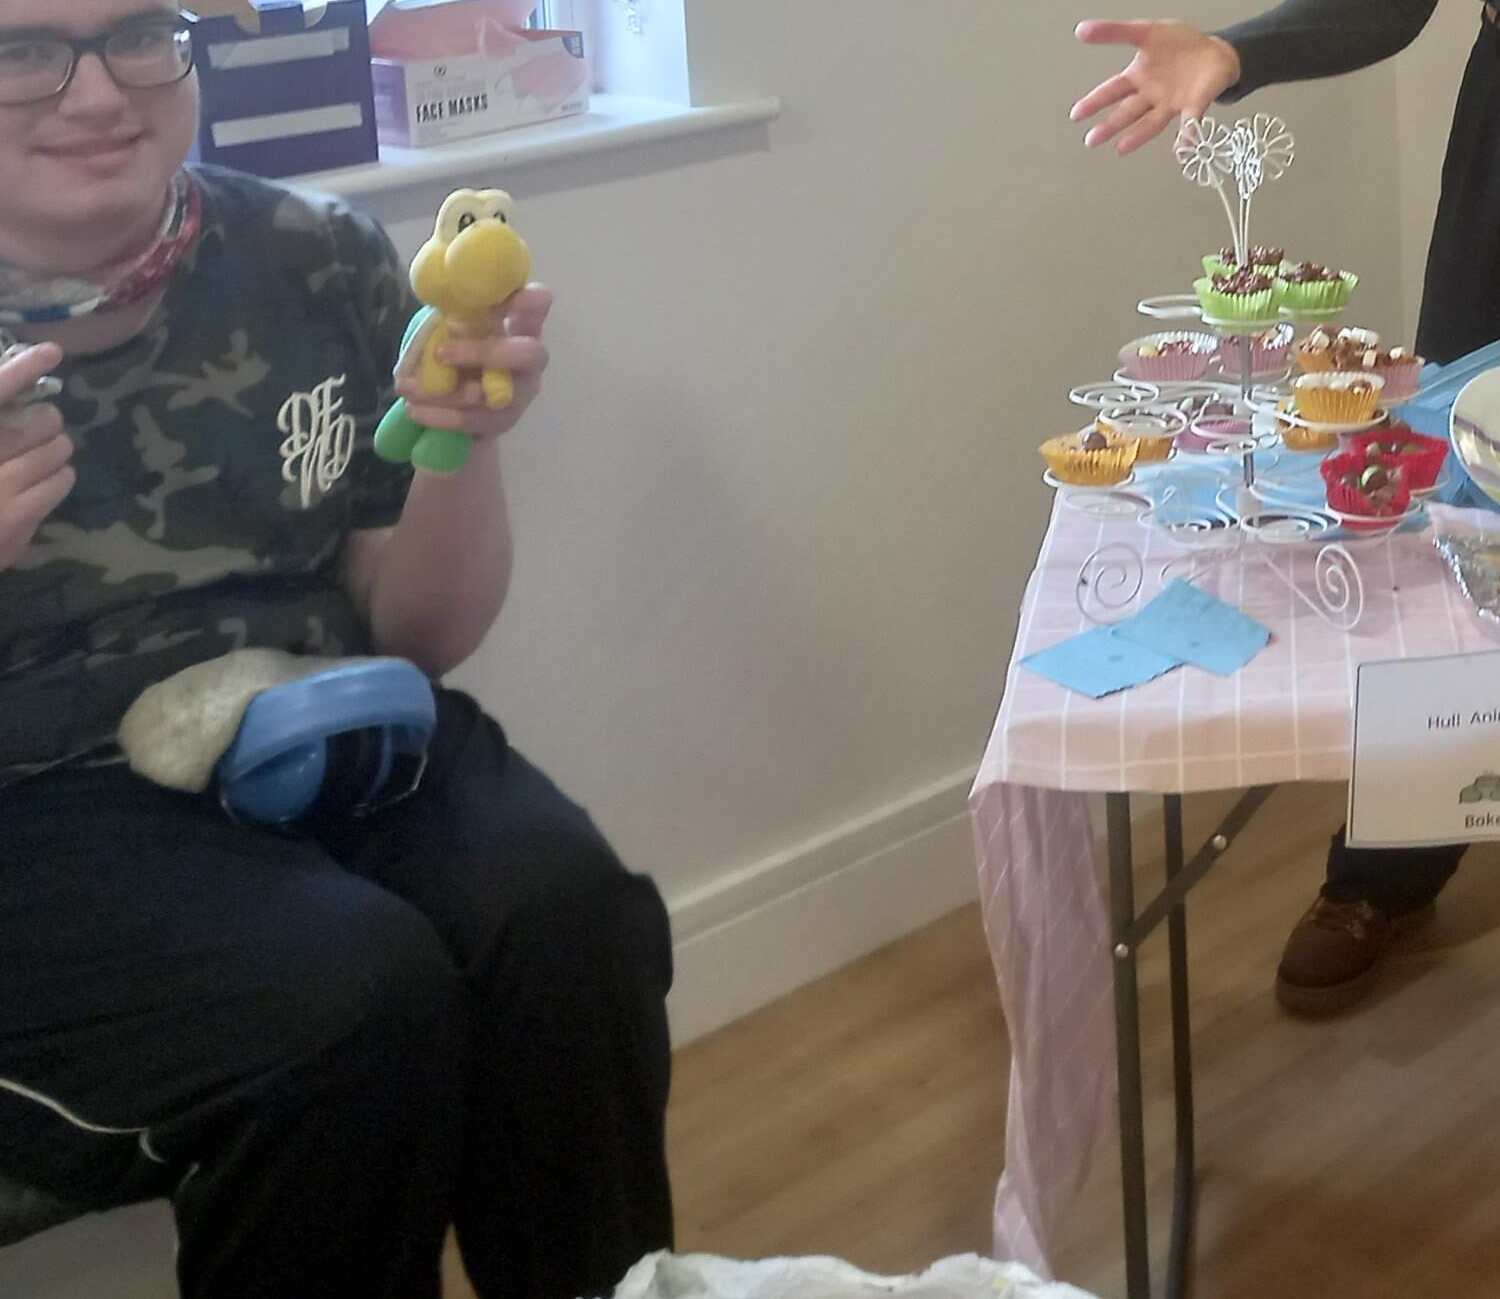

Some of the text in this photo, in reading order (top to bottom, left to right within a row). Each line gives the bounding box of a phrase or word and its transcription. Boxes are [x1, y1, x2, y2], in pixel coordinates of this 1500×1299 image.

[416, 93, 488, 123] FACE MASKS
[1427, 715, 1460, 730] Hull
